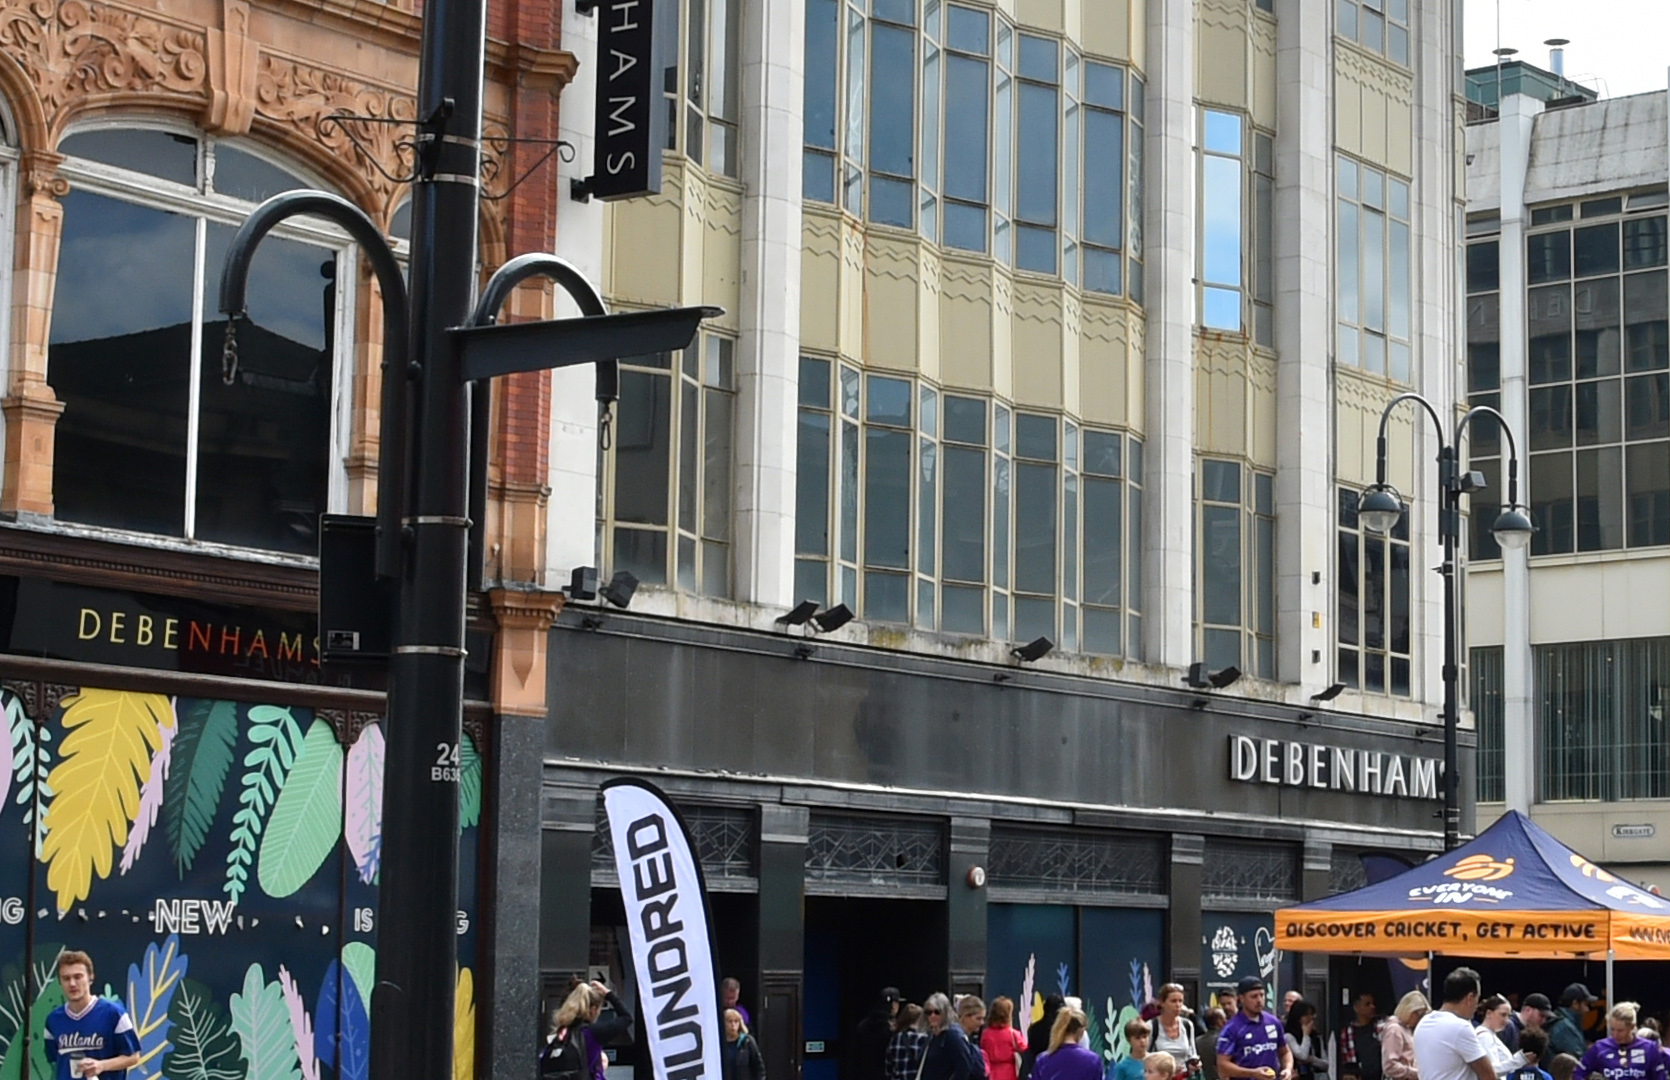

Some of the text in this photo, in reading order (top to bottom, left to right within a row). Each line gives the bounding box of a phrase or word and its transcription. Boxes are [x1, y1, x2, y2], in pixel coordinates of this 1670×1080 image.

[436, 742, 460, 766] 24
[1408, 882, 1514, 900] EVERYONE
[1433, 892, 1473, 904] IN
[154, 898, 235, 935] NEW
[354, 907, 374, 933] IS
[1286, 921, 1596, 941] DISCOVER CRICKET, GET ACTIVE
[58, 1031, 104, 1048] Atlanta
